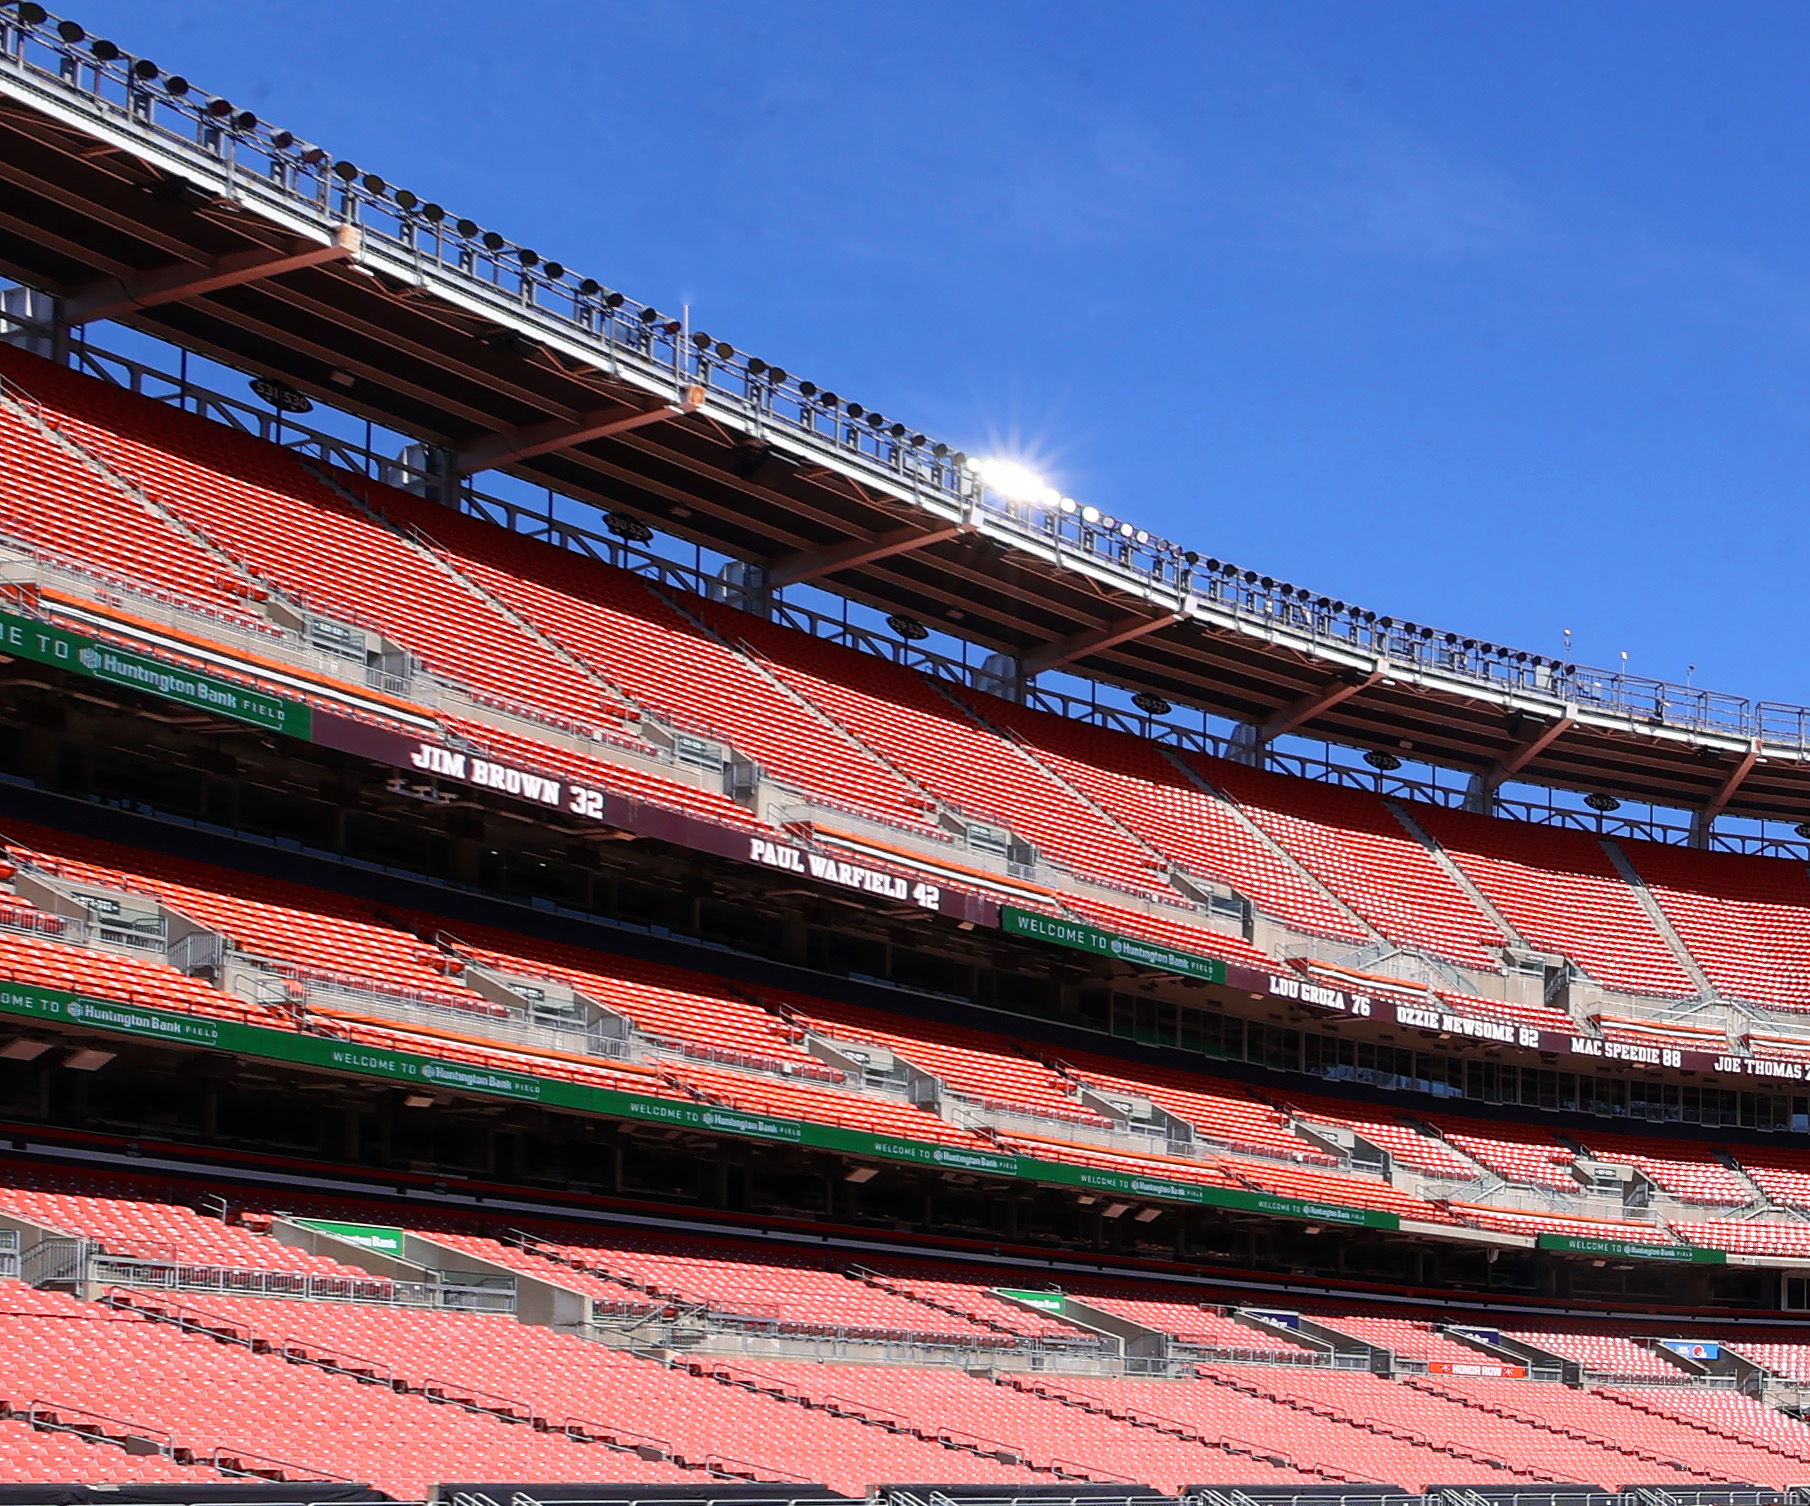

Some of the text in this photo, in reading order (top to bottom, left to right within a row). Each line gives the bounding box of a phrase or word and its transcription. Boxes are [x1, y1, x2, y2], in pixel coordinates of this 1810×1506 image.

[36, 634, 285, 721] TO Huntington Bank FIELD
[411, 744, 604, 819] JIM BROWN 32
[751, 838, 940, 910] PAUL WARFIELD 42
[1018, 916, 1189, 970] WELCOME TO Huntington Bank
[1269, 976, 1371, 1017] LOU GROZA 76
[40, 999, 60, 1014] TO
[85, 1004, 150, 1029] Huntington
[151, 1017, 181, 1034] Bank
[185, 1024, 219, 1039] FIELD
[1397, 1006, 1539, 1048] OZZIE NEWSOME 82
[1571, 1037, 1682, 1068] MAC SPEEDIE 88
[1714, 1056, 1742, 1073] JOE
[1744, 1059, 1801, 1080] THOMAS
[332, 1051, 512, 1091] WELCOME TO Huntington Bank
[631, 1103, 699, 1122] WELCOME TO
[875, 1142, 930, 1159] WELCOME TO
[1081, 1174, 1129, 1189] WELCOME TO
[1259, 1201, 1290, 1212] WELCOME
[1569, 1241, 1622, 1253] WELCOME TO
[1452, 1365, 1501, 1376] HONOR ROW
